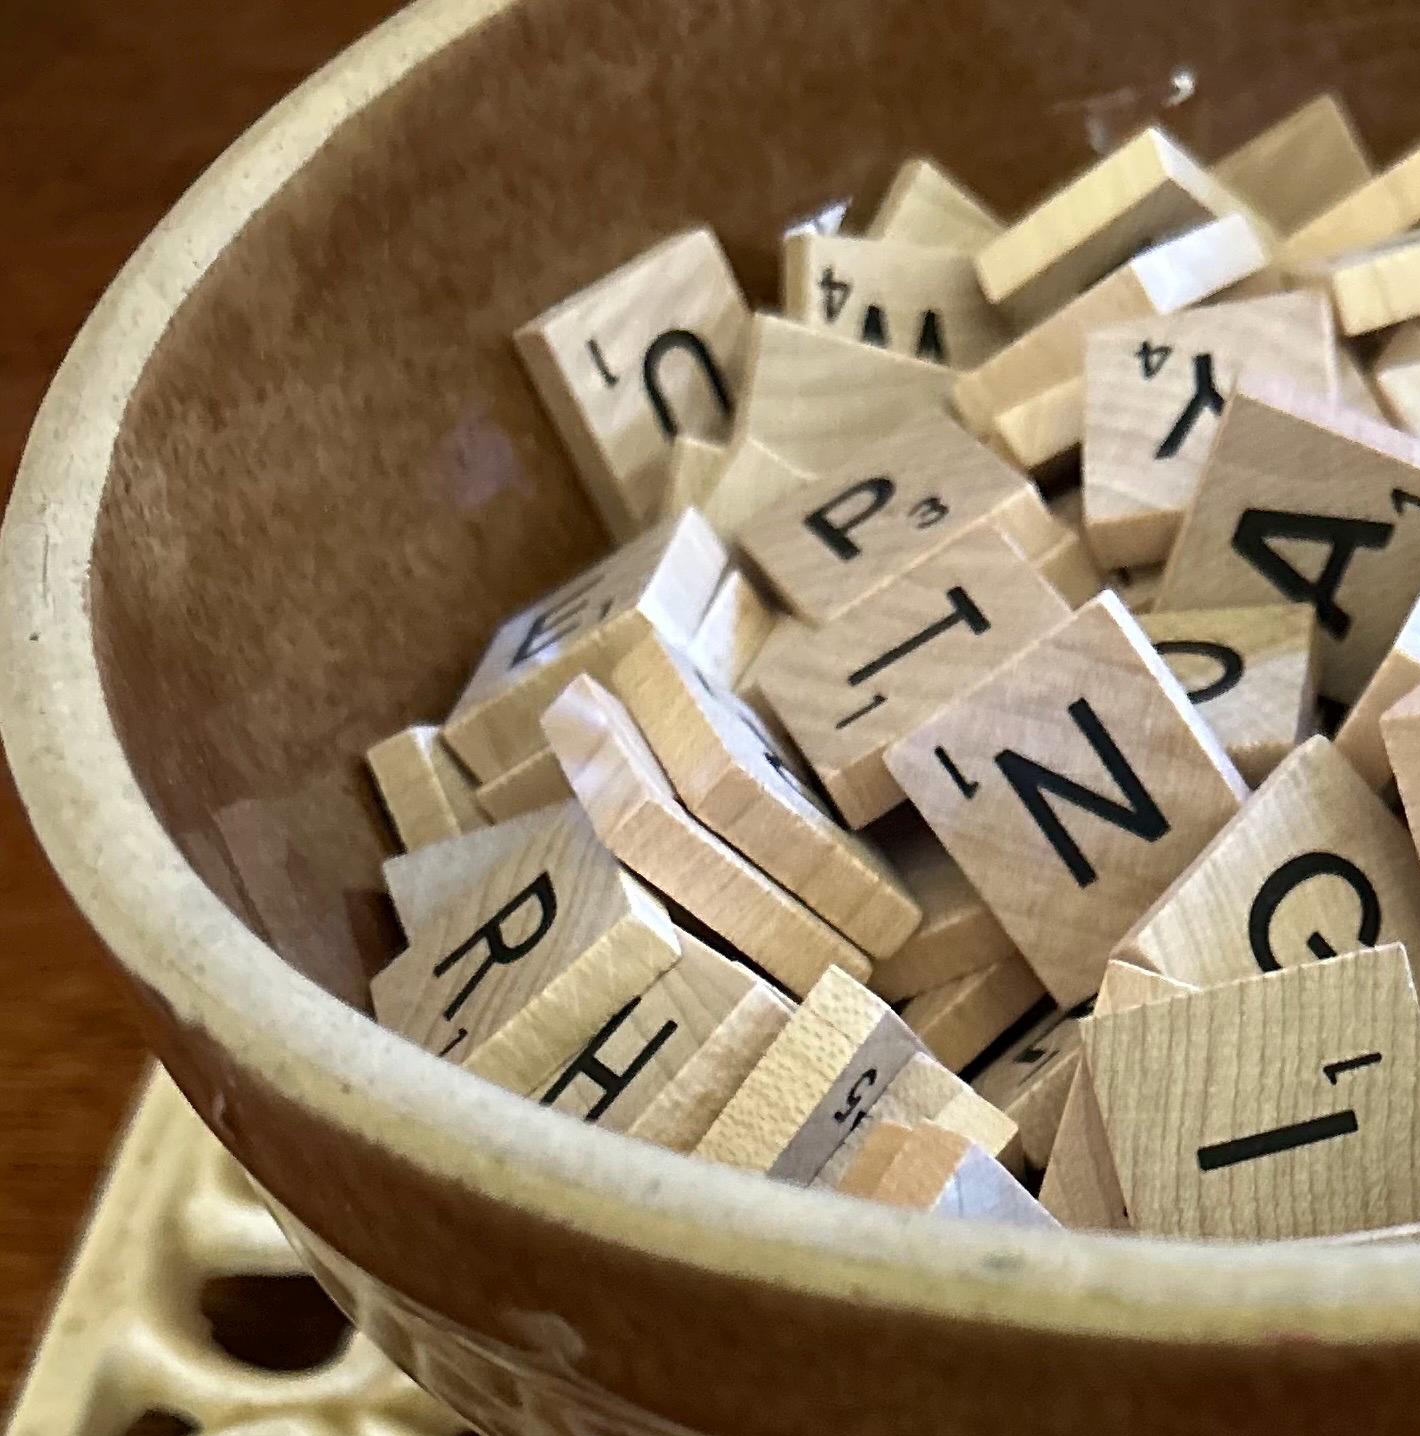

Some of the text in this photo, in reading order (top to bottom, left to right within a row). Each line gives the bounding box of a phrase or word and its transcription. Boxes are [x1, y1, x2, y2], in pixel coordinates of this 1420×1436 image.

[643, 329, 733, 440] U
[1135, 341, 1173, 379] 4
[803, 476, 949, 560] P 3
[1231, 508, 1394, 643] A
[847, 586, 991, 687] T
[935, 698, 1171, 889] N 1
[433, 871, 557, 1021] R
[1248, 852, 1383, 973] G
[539, 995, 678, 1122] H
[1323, 1053, 1382, 1085] 1
